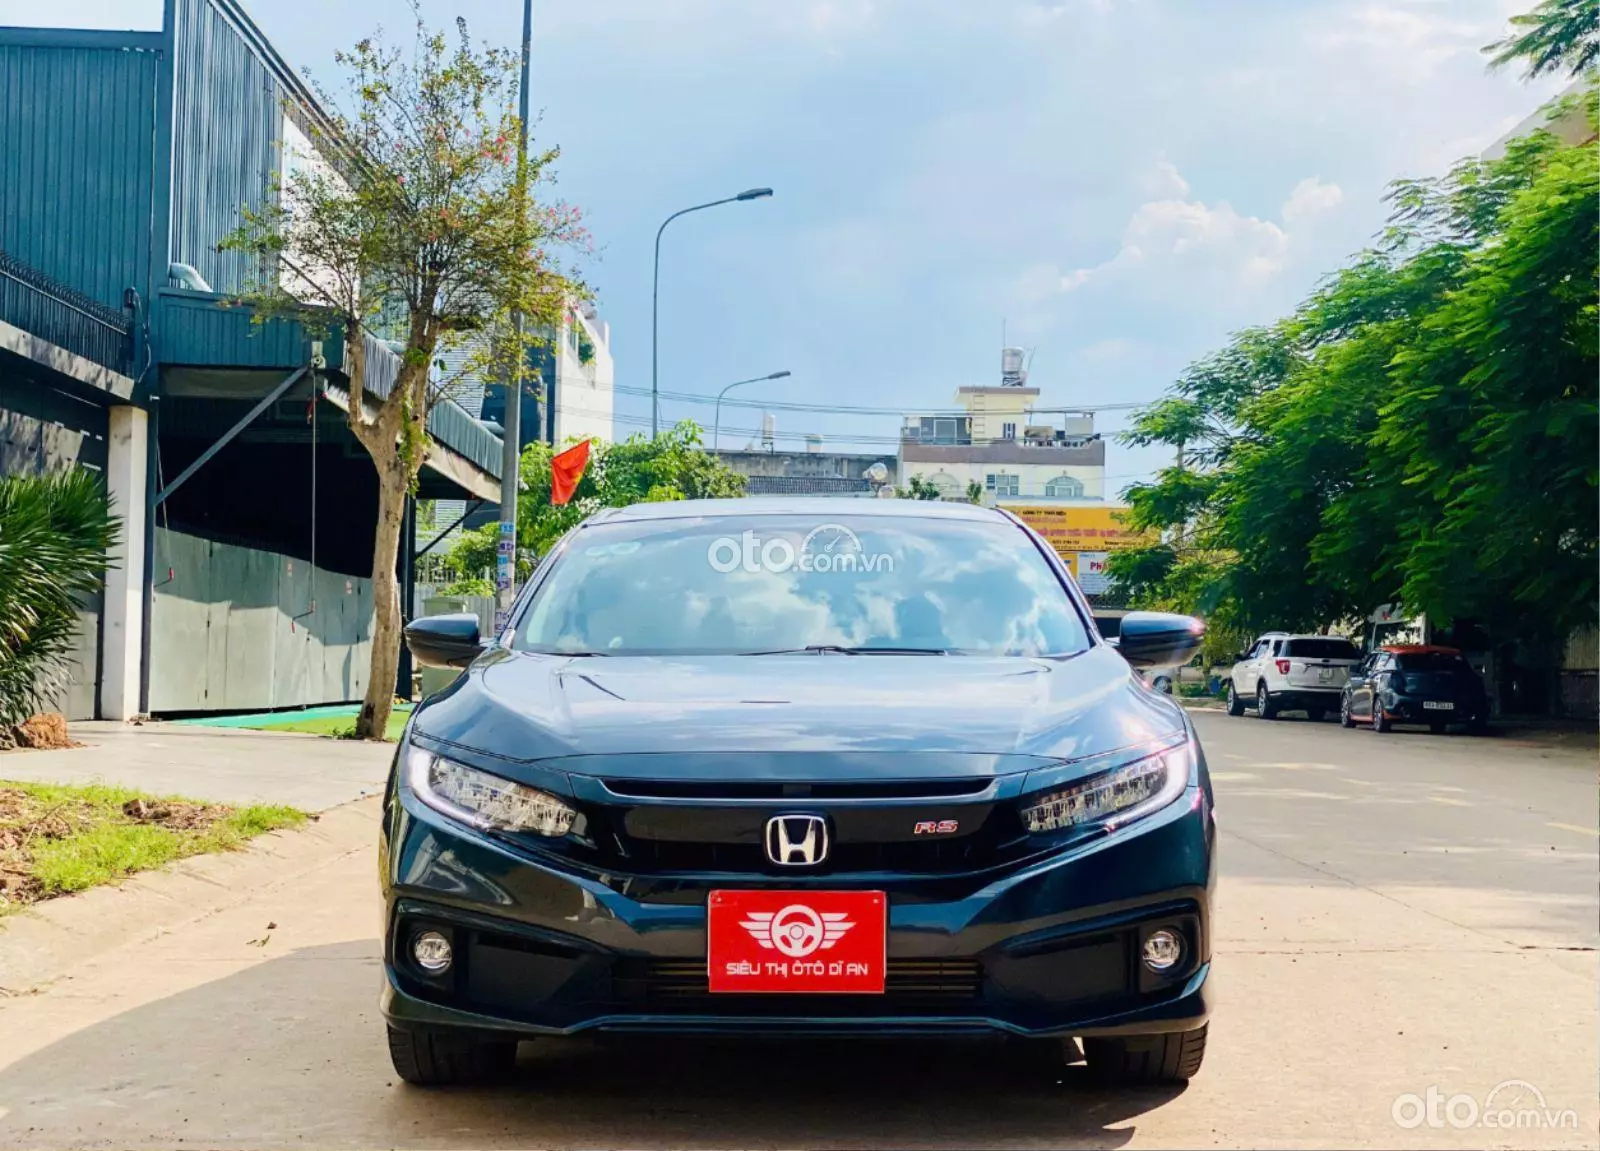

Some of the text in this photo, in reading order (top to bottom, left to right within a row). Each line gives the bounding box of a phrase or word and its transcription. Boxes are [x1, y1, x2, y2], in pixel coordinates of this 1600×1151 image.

[914, 819, 959, 834] RS
[726, 960, 761, 976] SIÊU
[765, 962, 788, 978] THỊ
[792, 960, 825, 976] ÔTÔ
[846, 963, 868, 976] AN
